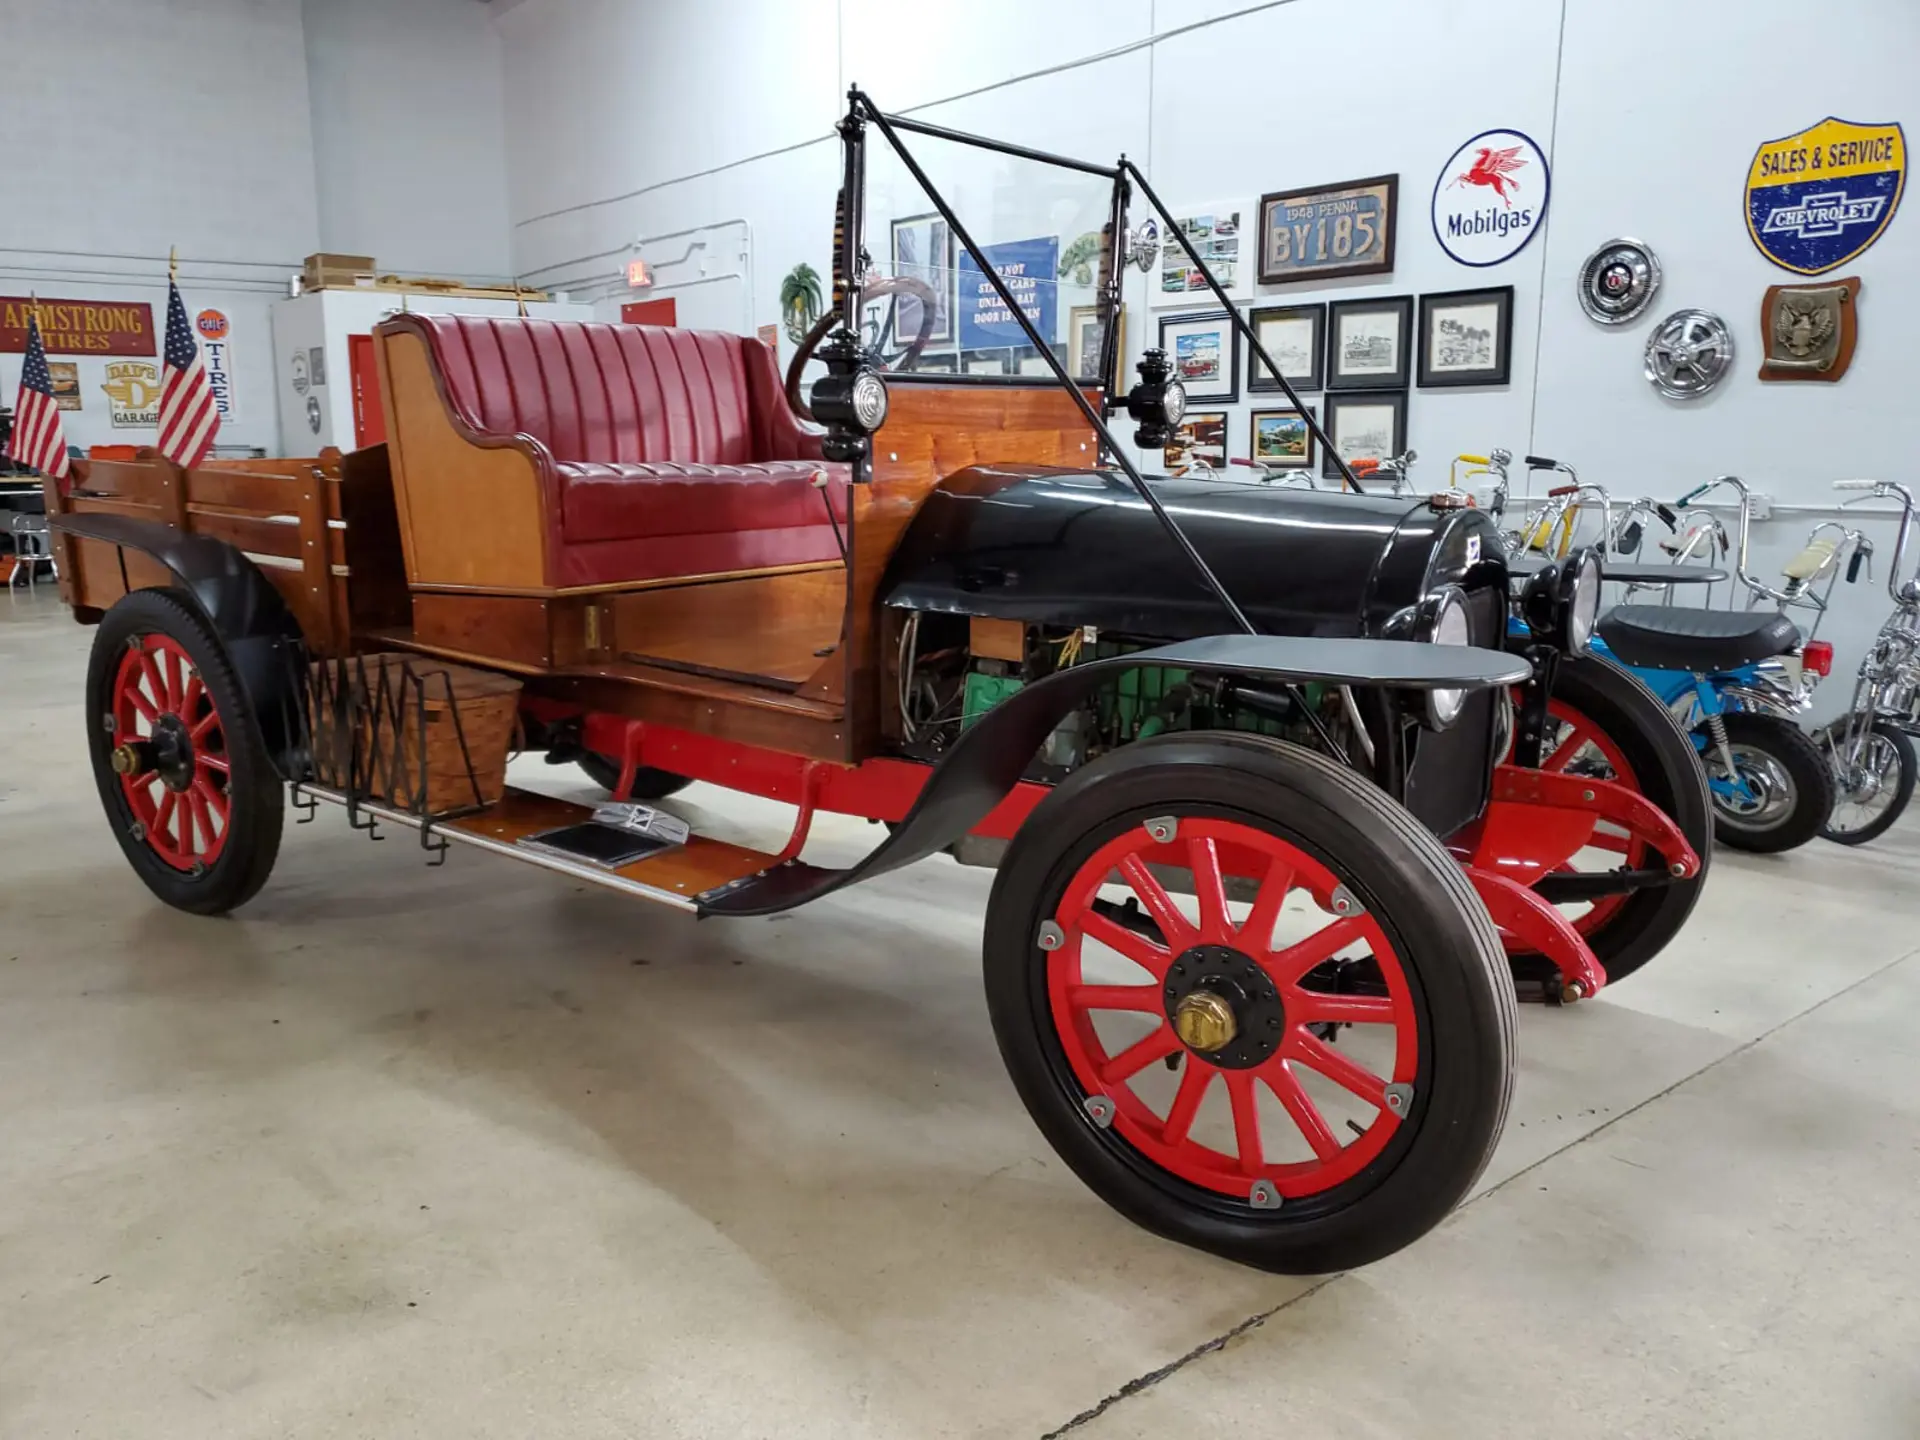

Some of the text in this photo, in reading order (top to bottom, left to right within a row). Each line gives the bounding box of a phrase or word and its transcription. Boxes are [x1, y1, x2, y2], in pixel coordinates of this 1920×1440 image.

[1761, 136, 1894, 177] SALES & SERVICE
[1286, 200, 1359, 221] 1948 PENNA
[1775, 203, 1873, 226] CHEVROLET
[1447, 207, 1531, 238] Mobilgas
[1273, 211, 1376, 264] BY185
[1005, 263, 1025, 275] NOT
[978, 278, 1036, 294] STAT CARS
[979, 297, 1010, 308] UNLE
[4, 303, 142, 333] ARMSTRONG
[200, 318, 225, 331] GULF
[974, 312, 999, 323] DOOR
[1002, 311, 1011, 321] IS
[42, 332, 111, 349] TIRES
[109, 364, 156, 380] DAD'S
[205, 343, 229, 413] TIRES
